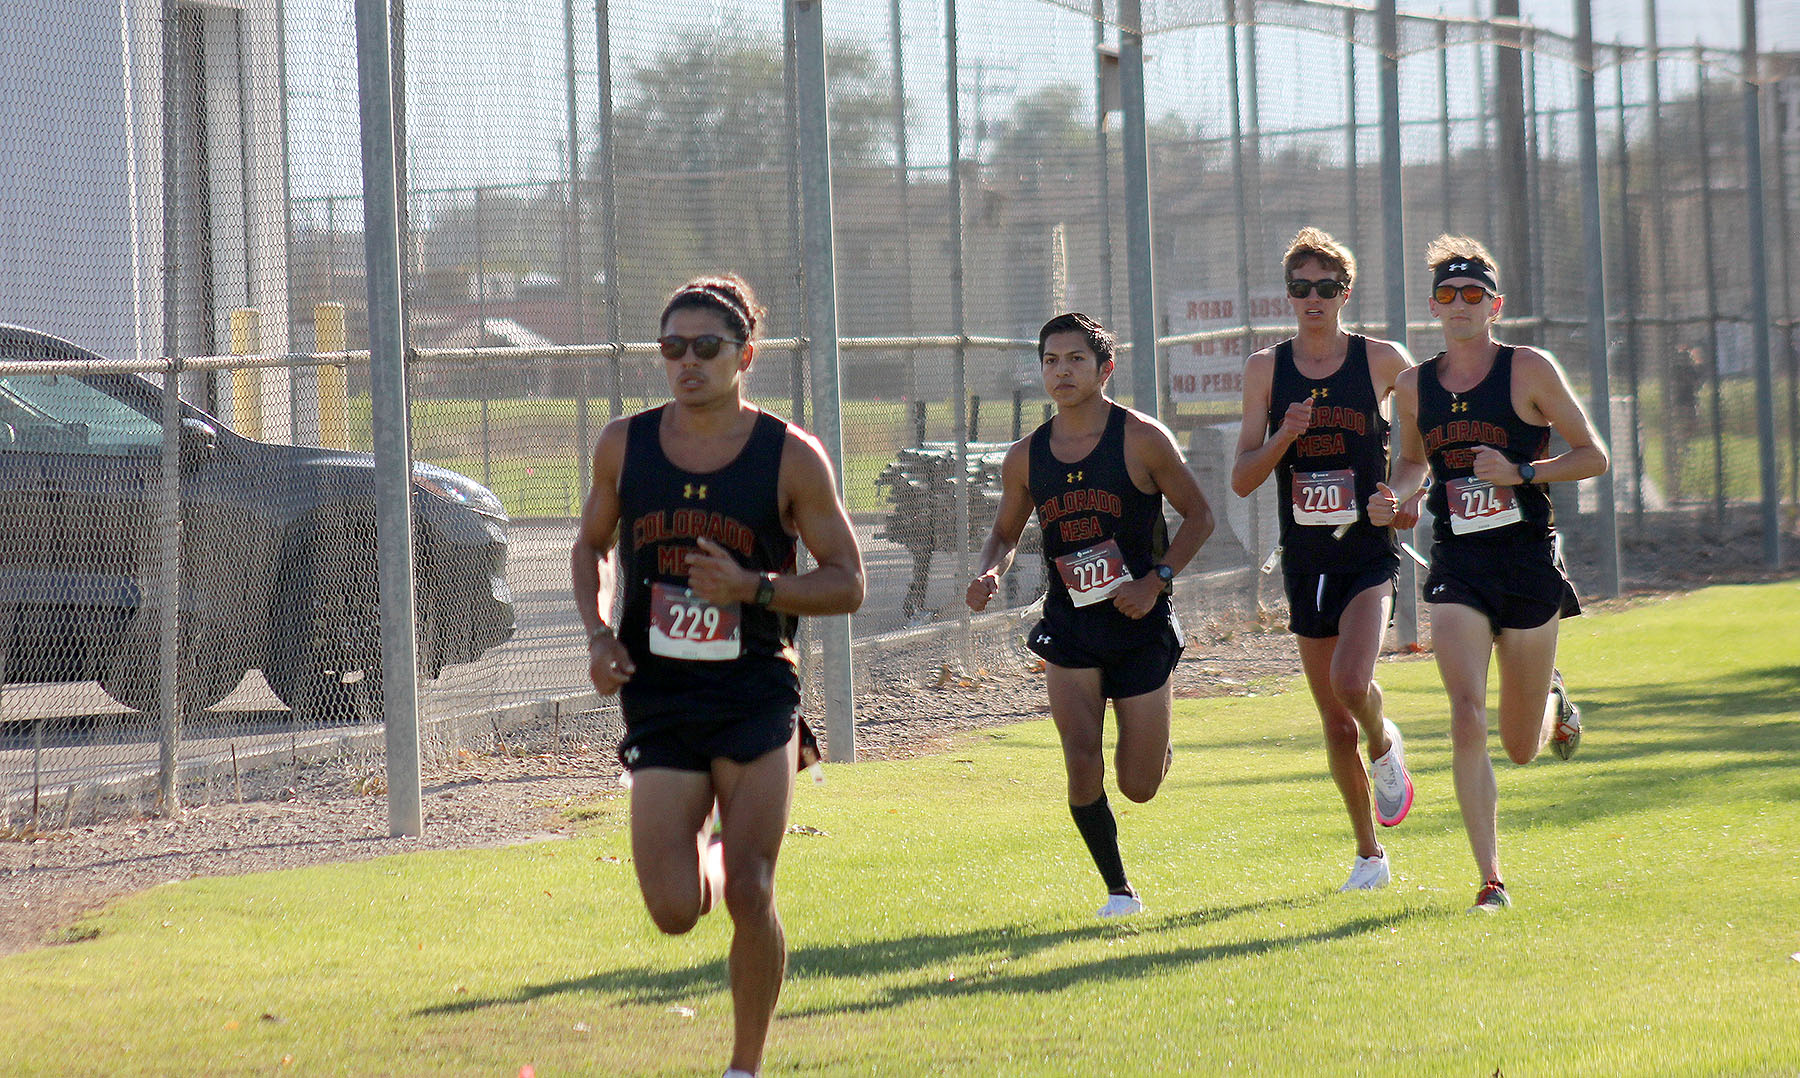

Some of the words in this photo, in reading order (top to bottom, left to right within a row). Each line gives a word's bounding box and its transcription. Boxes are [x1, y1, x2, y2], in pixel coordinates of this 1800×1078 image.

[1187, 300, 1233, 320] ROAD
[1173, 375, 1196, 394] NO
[1201, 373, 1243, 393] PEDE
[1309, 406, 1365, 436] ORADO
[1297, 433, 1345, 457] MESA
[1424, 421, 1508, 456] COLORADO
[1442, 448, 1477, 469] MES
[1040, 489, 1122, 529] COLORADO
[1302, 485, 1339, 510] 220
[1461, 487, 1501, 517] 224
[634, 509, 755, 558] COLORADO
[1060, 516, 1103, 542] MESA
[658, 545, 692, 576] ME
[1073, 558, 1114, 590] 222
[669, 604, 720, 639] 229
